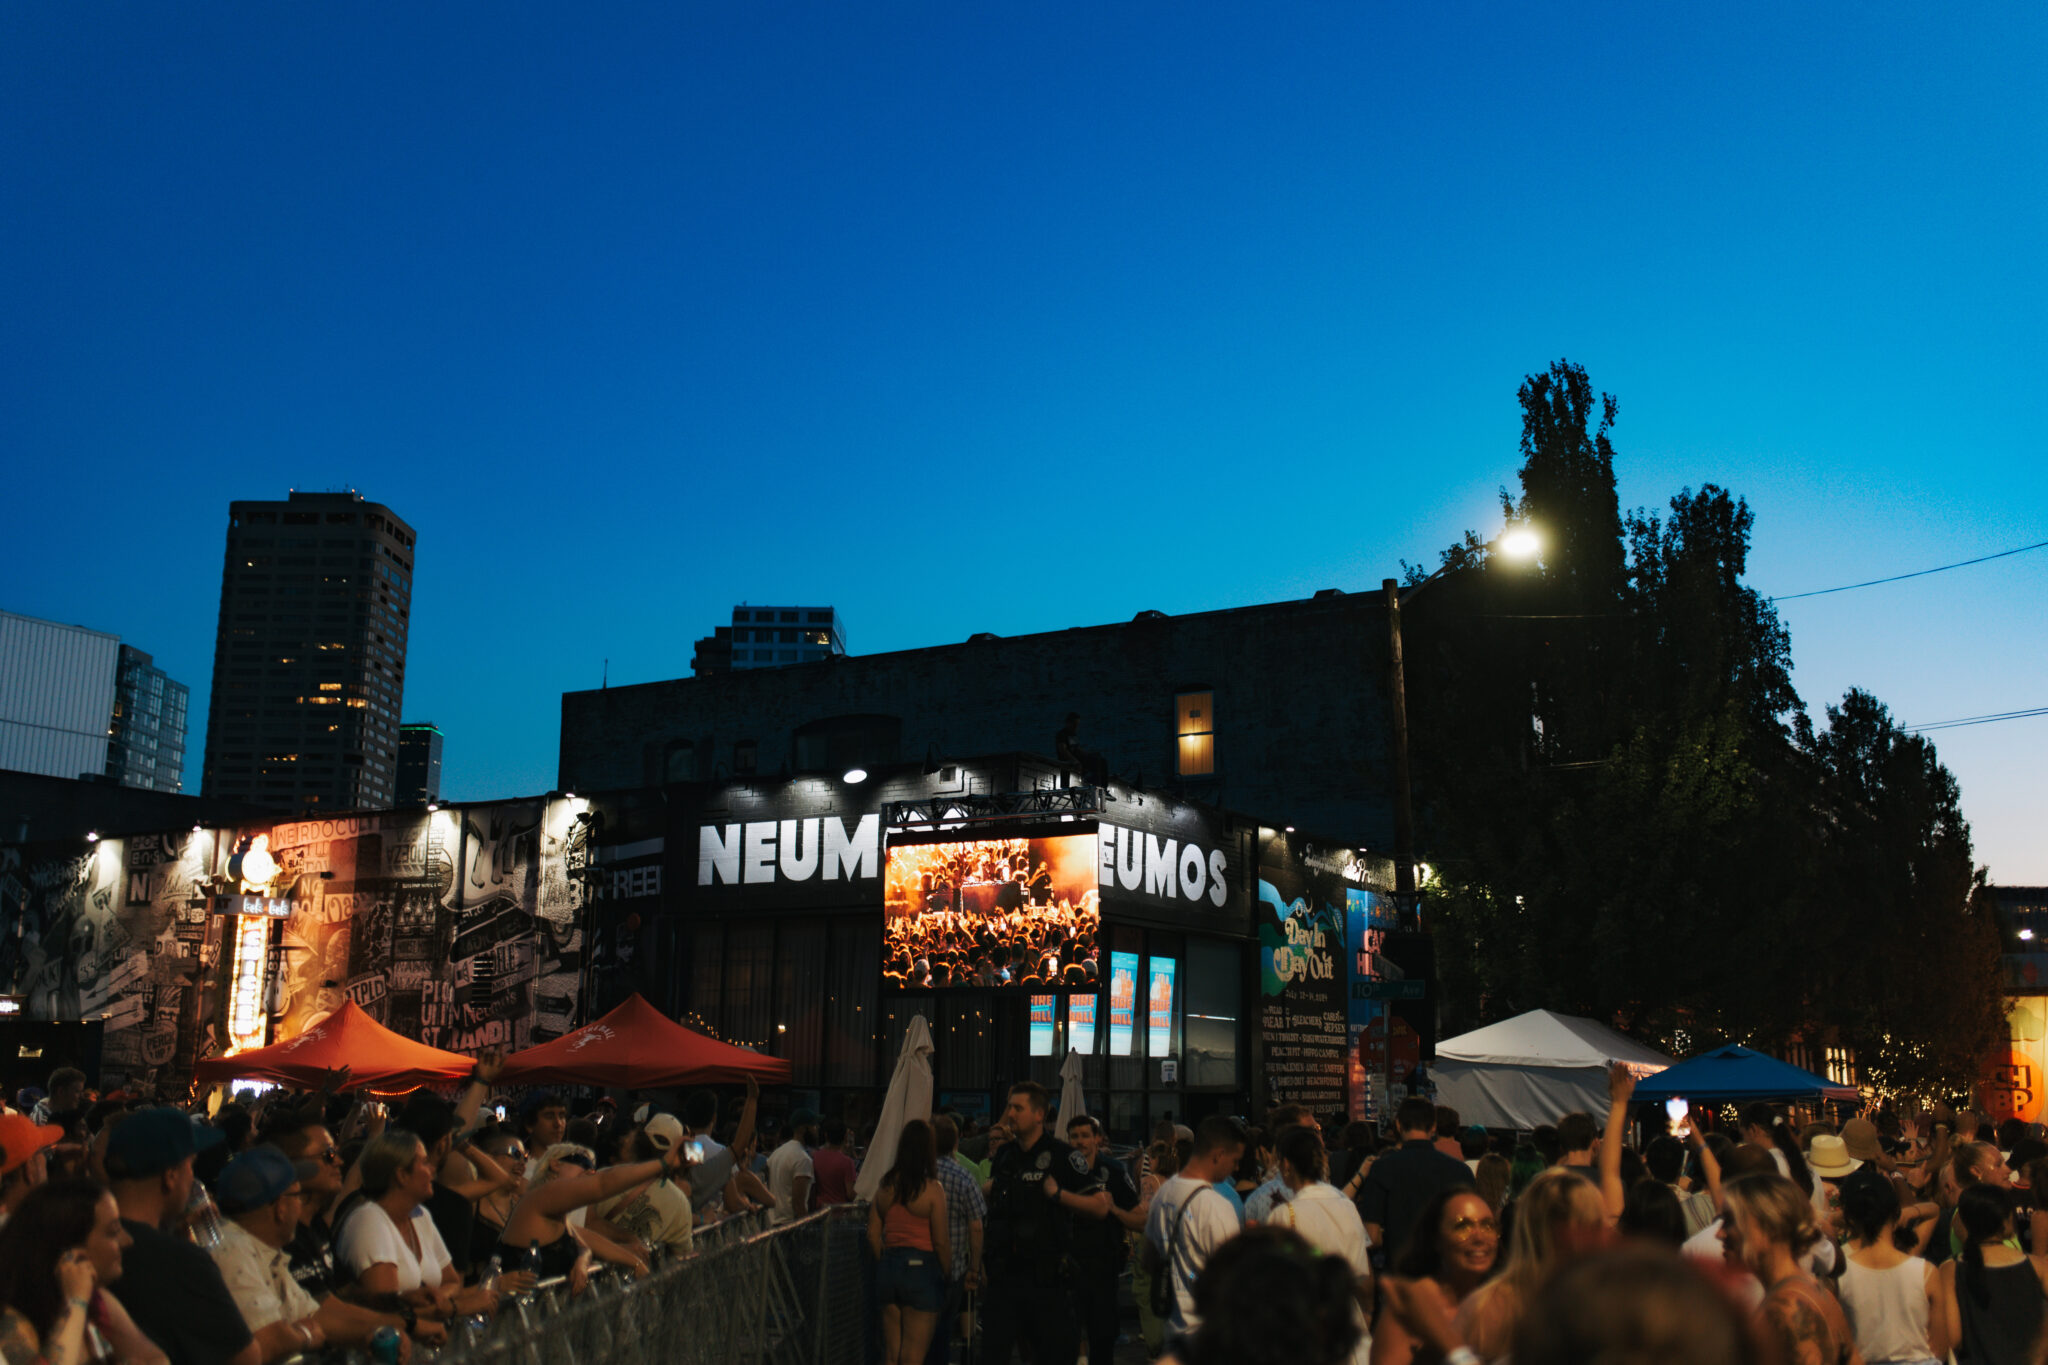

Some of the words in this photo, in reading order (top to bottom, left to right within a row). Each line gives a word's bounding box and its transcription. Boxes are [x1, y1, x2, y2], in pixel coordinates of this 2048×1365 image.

[698, 810, 940, 887] NEUM
[1098, 822, 1228, 907] EUMOS
[1284, 917, 1313, 949] Day
[1313, 922, 1326, 948] In
[1273, 946, 1312, 982] Day
[1311, 951, 1334, 979] Out
[1402, 985, 1419, 996] Ave
